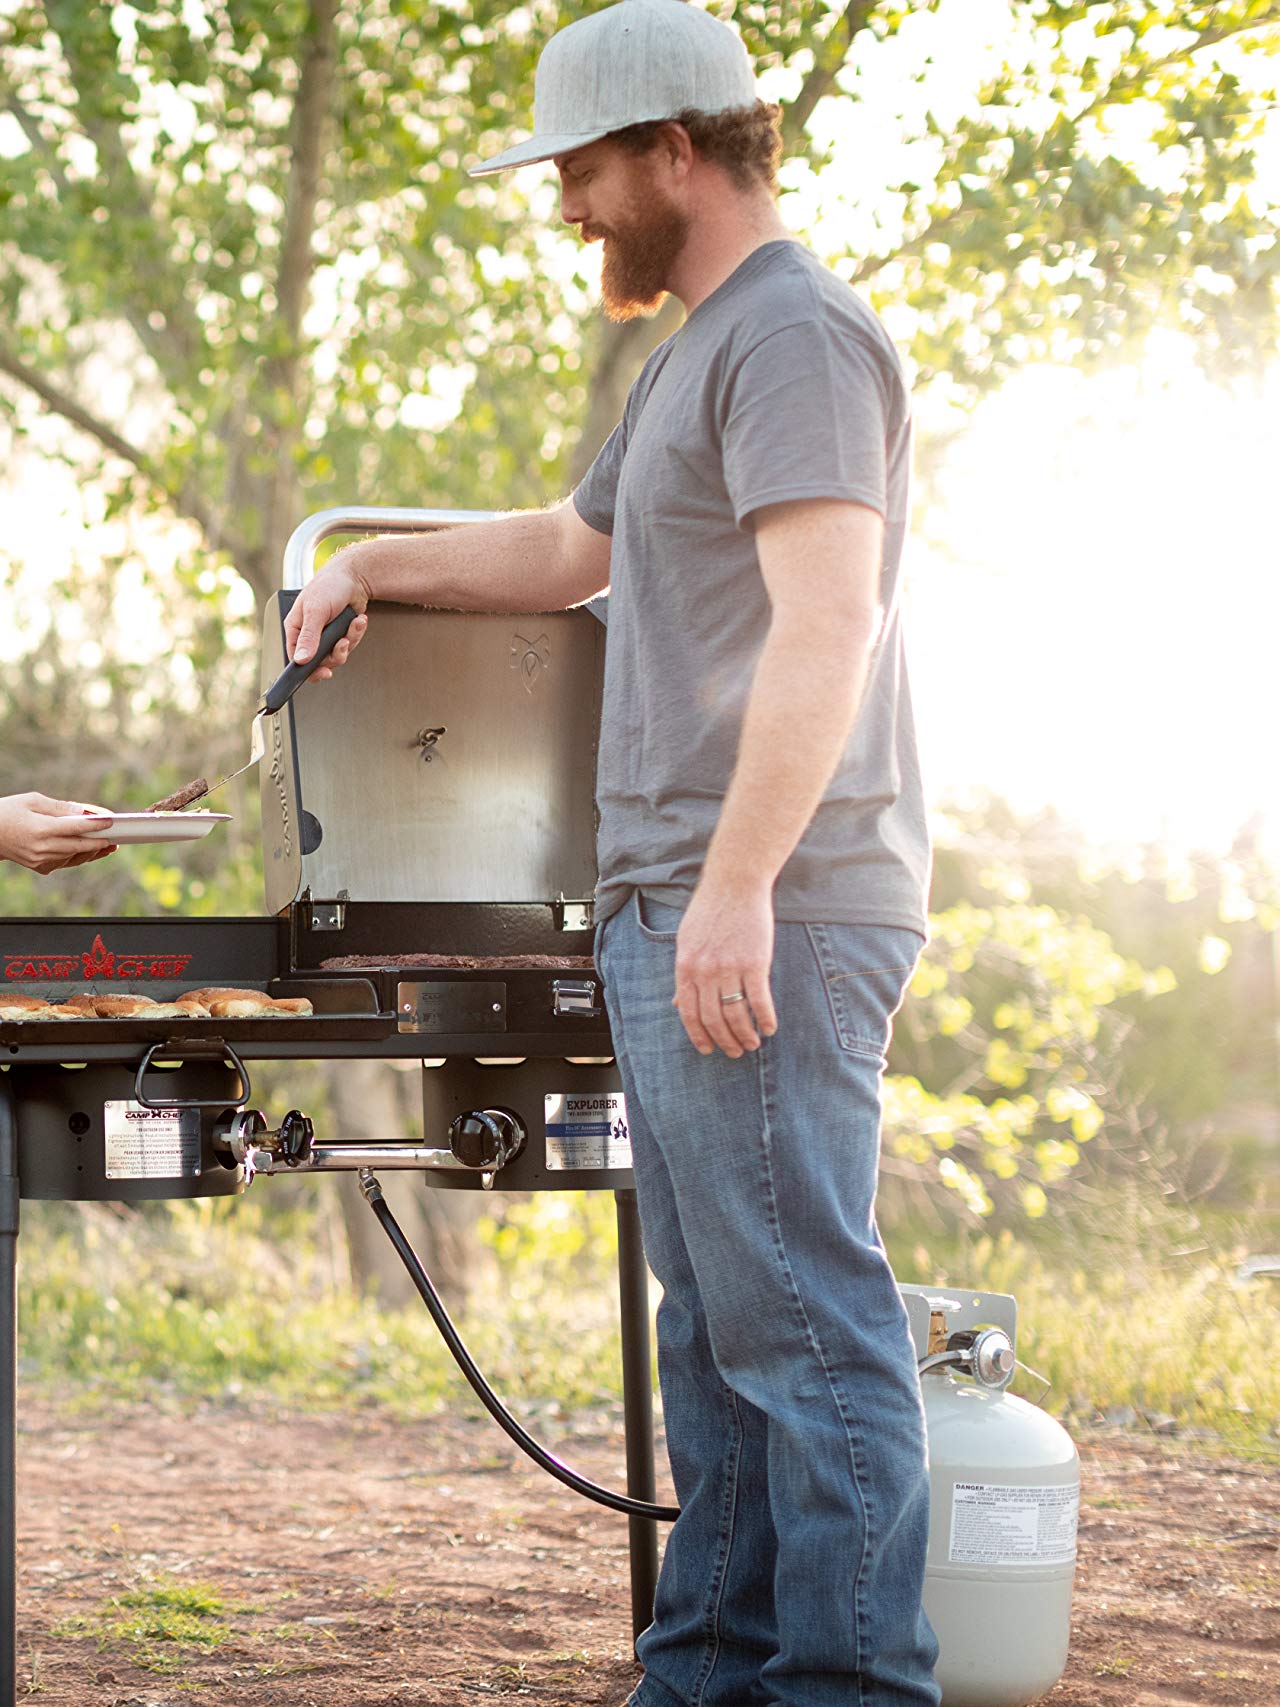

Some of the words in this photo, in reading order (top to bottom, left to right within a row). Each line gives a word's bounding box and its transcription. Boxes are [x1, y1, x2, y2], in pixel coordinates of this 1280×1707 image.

[5, 961, 79, 978] CAMP
[117, 960, 189, 978] CHEF
[567, 1099, 618, 1110] EXPLORER
